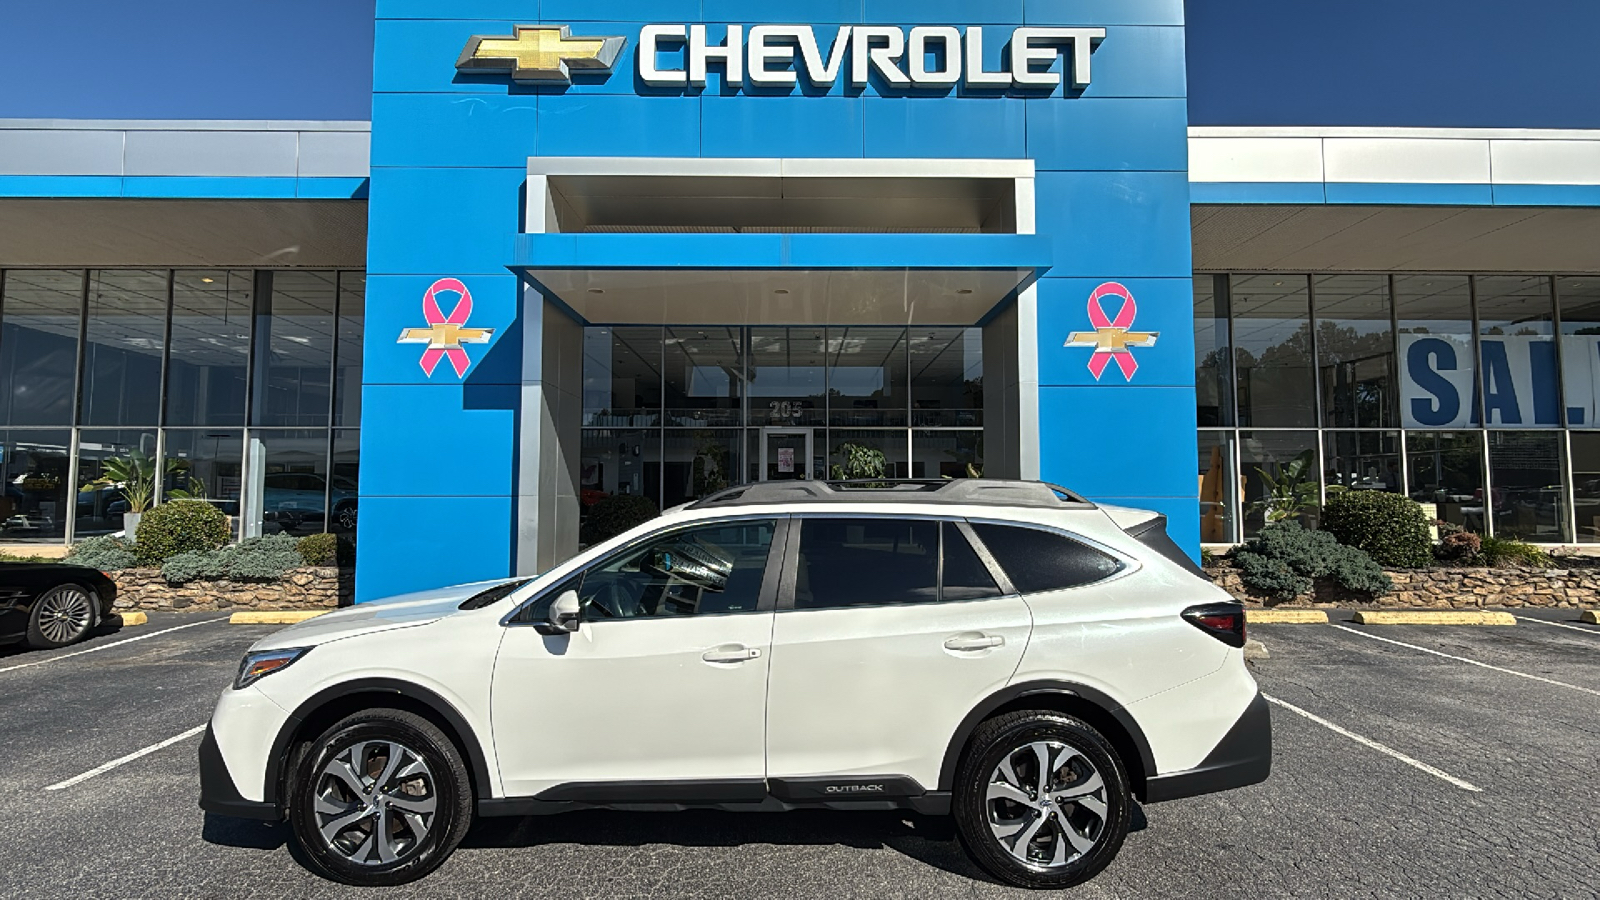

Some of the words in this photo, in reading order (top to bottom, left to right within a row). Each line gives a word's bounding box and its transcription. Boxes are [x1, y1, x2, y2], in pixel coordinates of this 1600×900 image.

[638, 24, 1106, 88] CHEVROLET
[770, 400, 803, 418] 205
[1407, 338, 1600, 426] SAL
